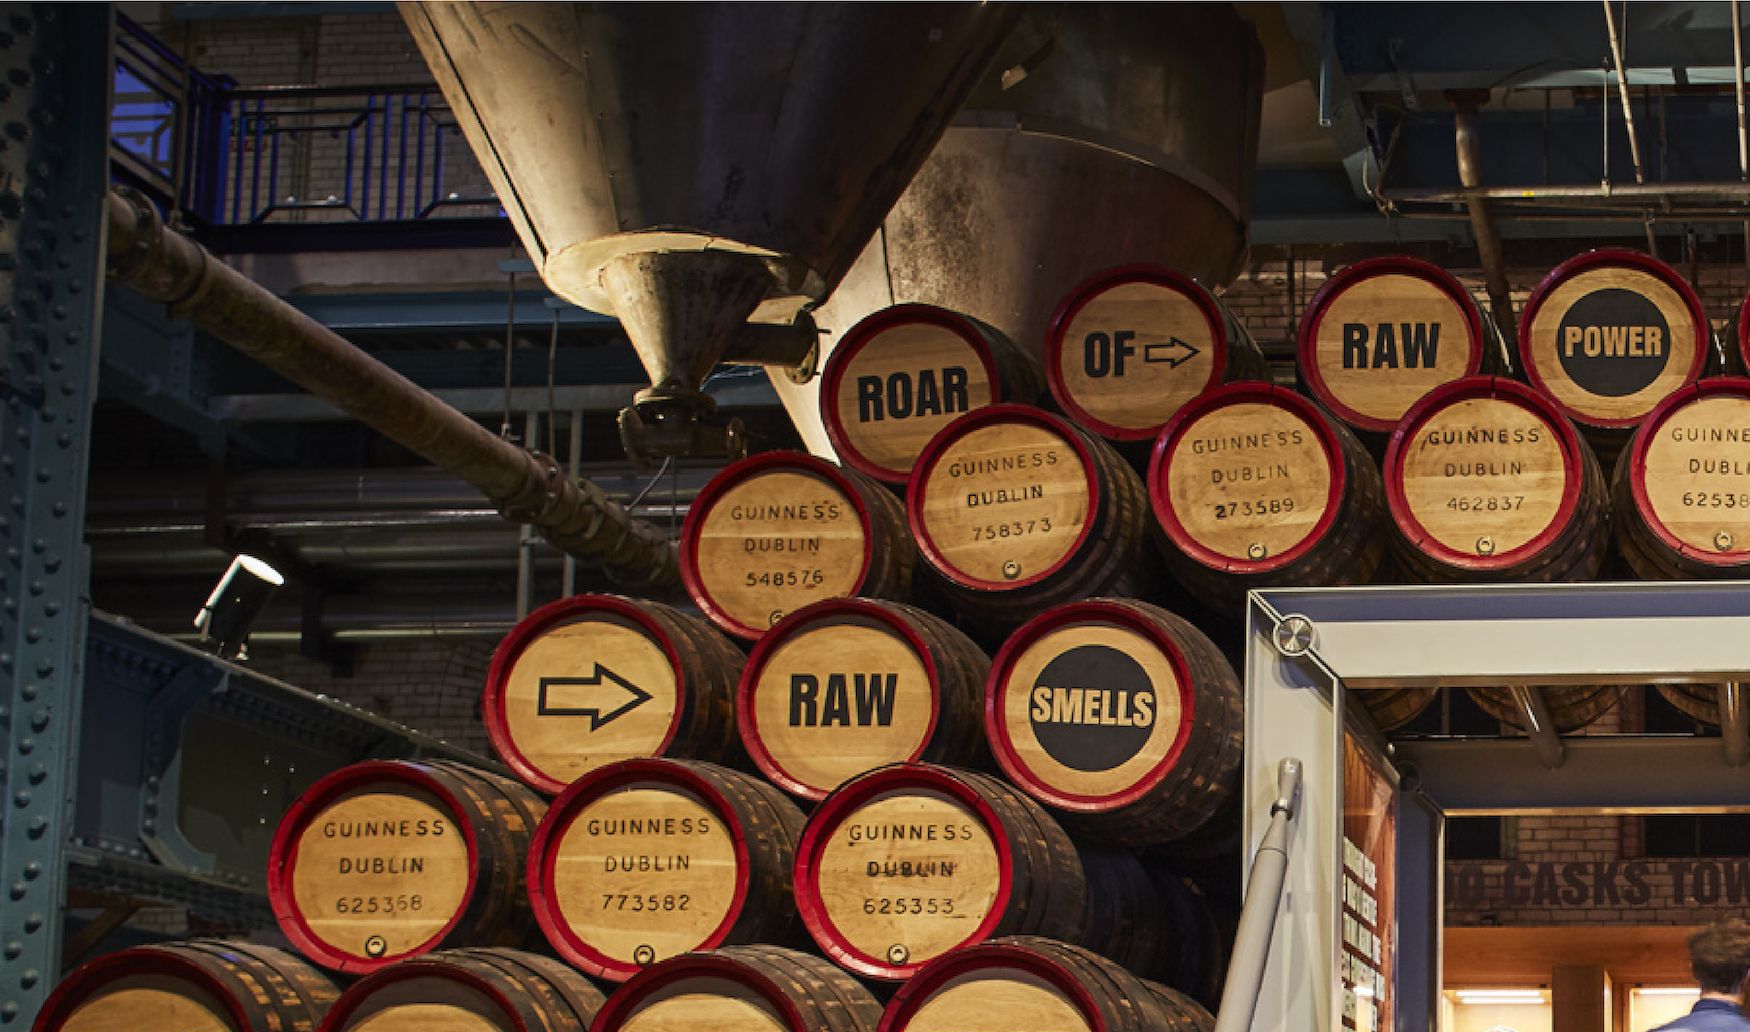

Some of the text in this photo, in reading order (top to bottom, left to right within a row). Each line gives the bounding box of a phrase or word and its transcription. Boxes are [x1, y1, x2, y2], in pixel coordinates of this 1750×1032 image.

[1342, 323, 1441, 369] RAW
[1564, 325, 1662, 358] POWER
[1083, 330, 1135, 378] OF
[857, 367, 969, 423] ROAR
[1192, 430, 1303, 454] GUINNESS
[1429, 427, 1540, 446] GUINNESS
[949, 452, 1058, 478] GUINNESS
[1211, 464, 1290, 483] DUBLIN
[1444, 459, 1522, 477] DUBLIN
[966, 484, 1043, 508] DUBLIN
[1447, 495, 1525, 512] 462837
[730, 503, 840, 521] GUINNESS
[1215, 498, 1294, 519] 273589
[972, 517, 1053, 541] 758373
[744, 537, 821, 553] DUBLIN
[745, 568, 824, 588] 548576
[789, 672, 897, 728] RAW
[1031, 685, 1155, 728] SMELLS
[324, 819, 445, 838] GUINNESS
[587, 817, 710, 837] GUINNESS
[849, 824, 973, 840] GUINNESS
[340, 857, 424, 873] DUBLIN
[604, 855, 690, 873] DUBLIN
[867, 861, 954, 877] DUBLIN
[1504, 861, 1651, 906] CASKS
[601, 893, 690, 912] 773582
[863, 898, 954, 914] 625353
